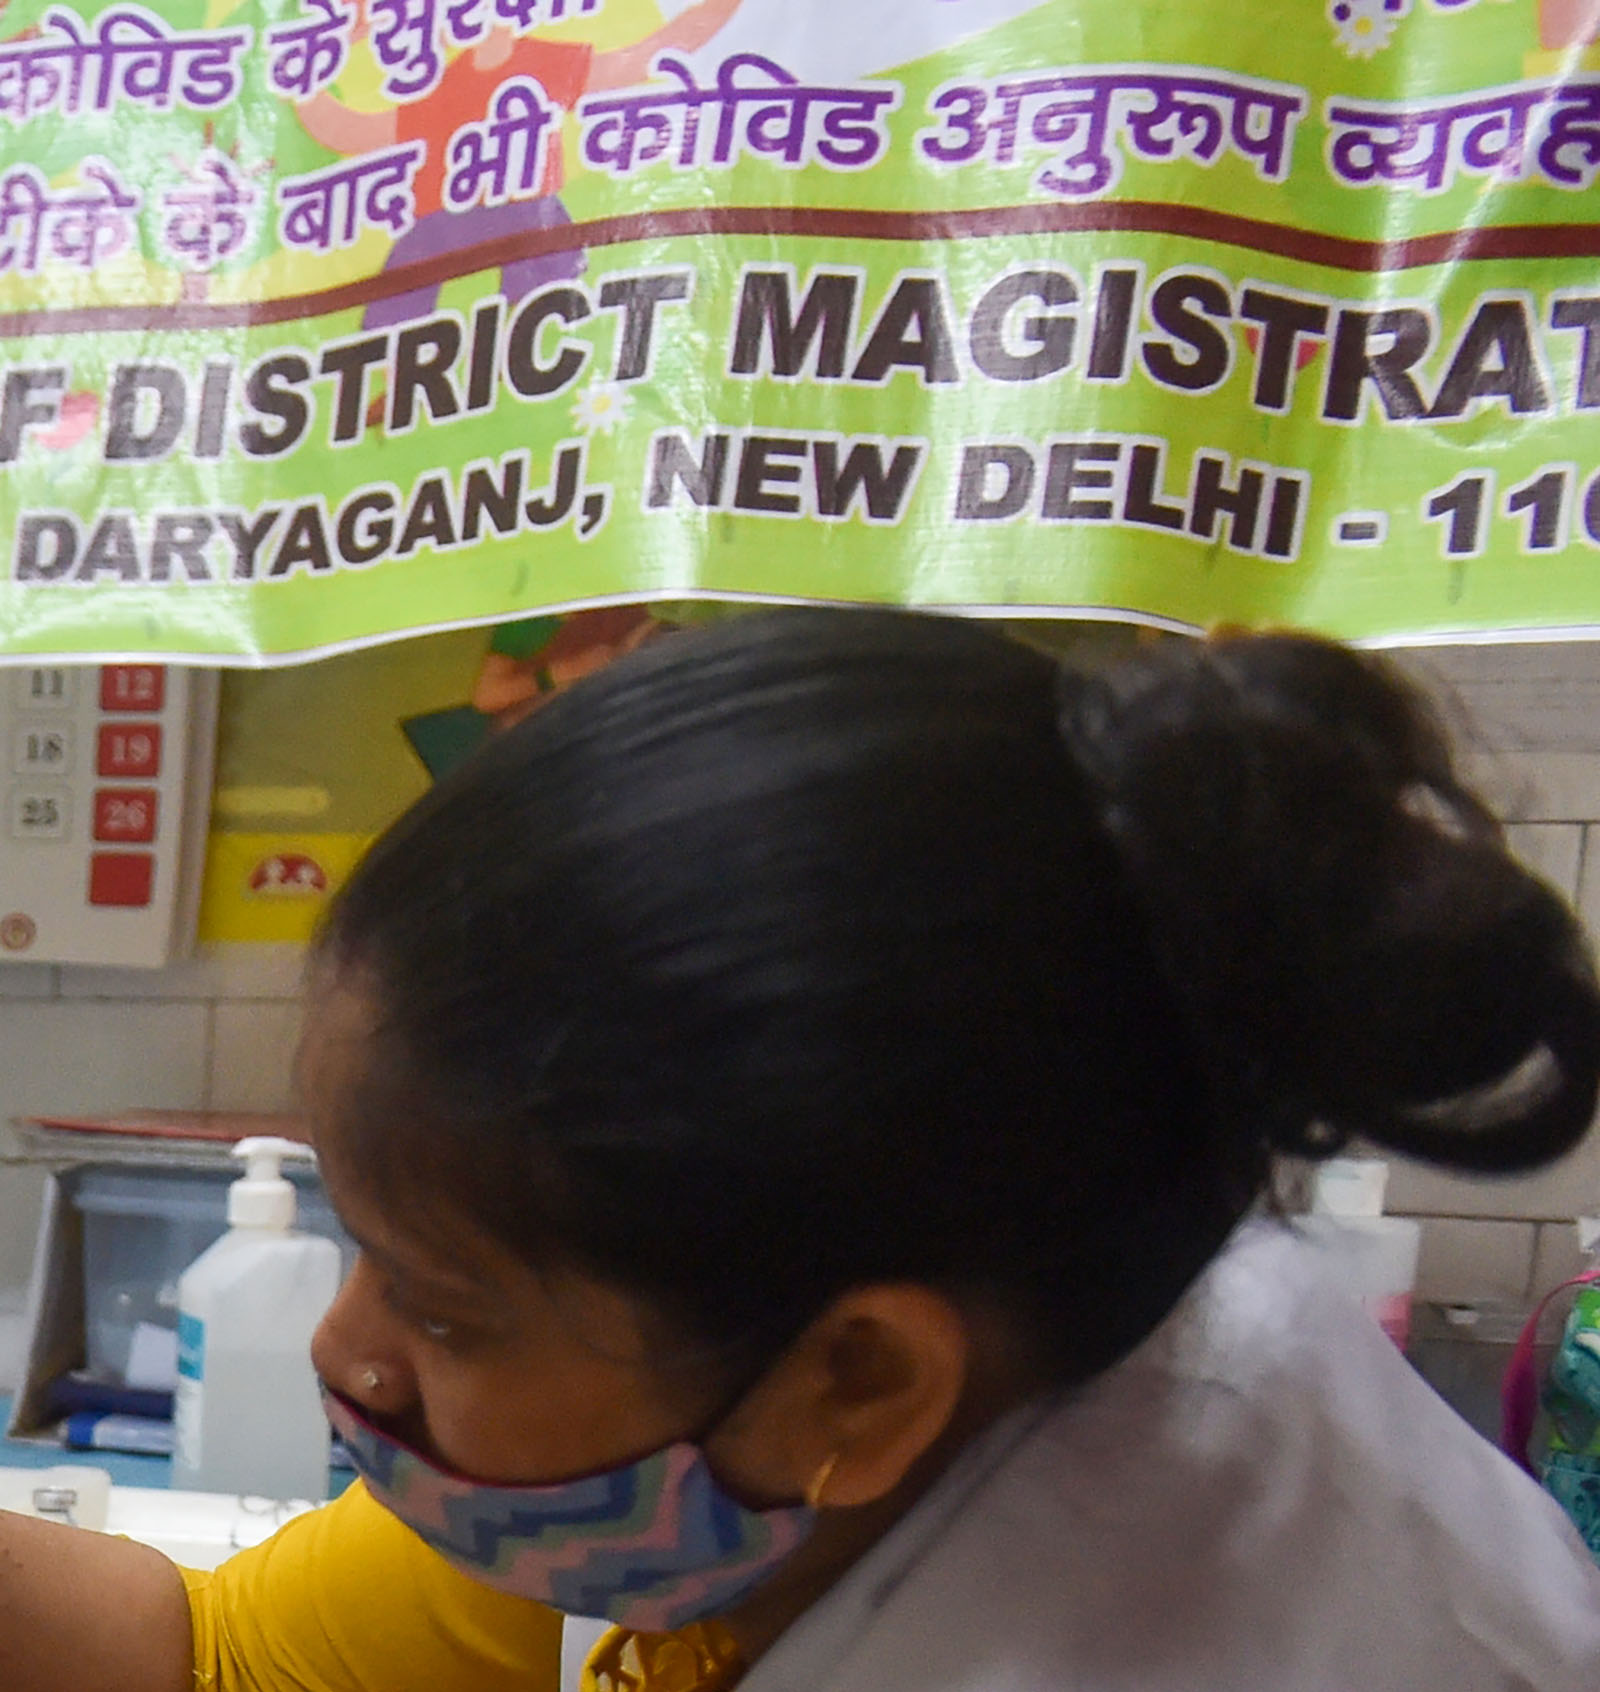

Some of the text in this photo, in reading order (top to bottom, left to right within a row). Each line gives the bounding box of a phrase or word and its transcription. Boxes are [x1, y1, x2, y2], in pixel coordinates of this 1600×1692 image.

[272, 1, 347, 96] के
[160, 160, 254, 263] के
[282, 143, 424, 252] बाद
[448, 86, 550, 206] भी
[583, 54, 895, 171] कोविड
[922, 72, 1302, 195] अनुरूप
[103, 271, 688, 463] DISTRICT
[15, 447, 603, 585] DARYAGANJ,
[647, 433, 920, 521] NEW
[956, 443, 1303, 558] DELHI
[1428, 470, 1600, 556] 11
[31, 668, 64, 697] 11
[115, 667, 155, 699] 12
[26, 732, 64, 763] 18
[111, 734, 152, 765] 19
[21, 797, 59, 826] 25
[105, 798, 148, 830] 26
